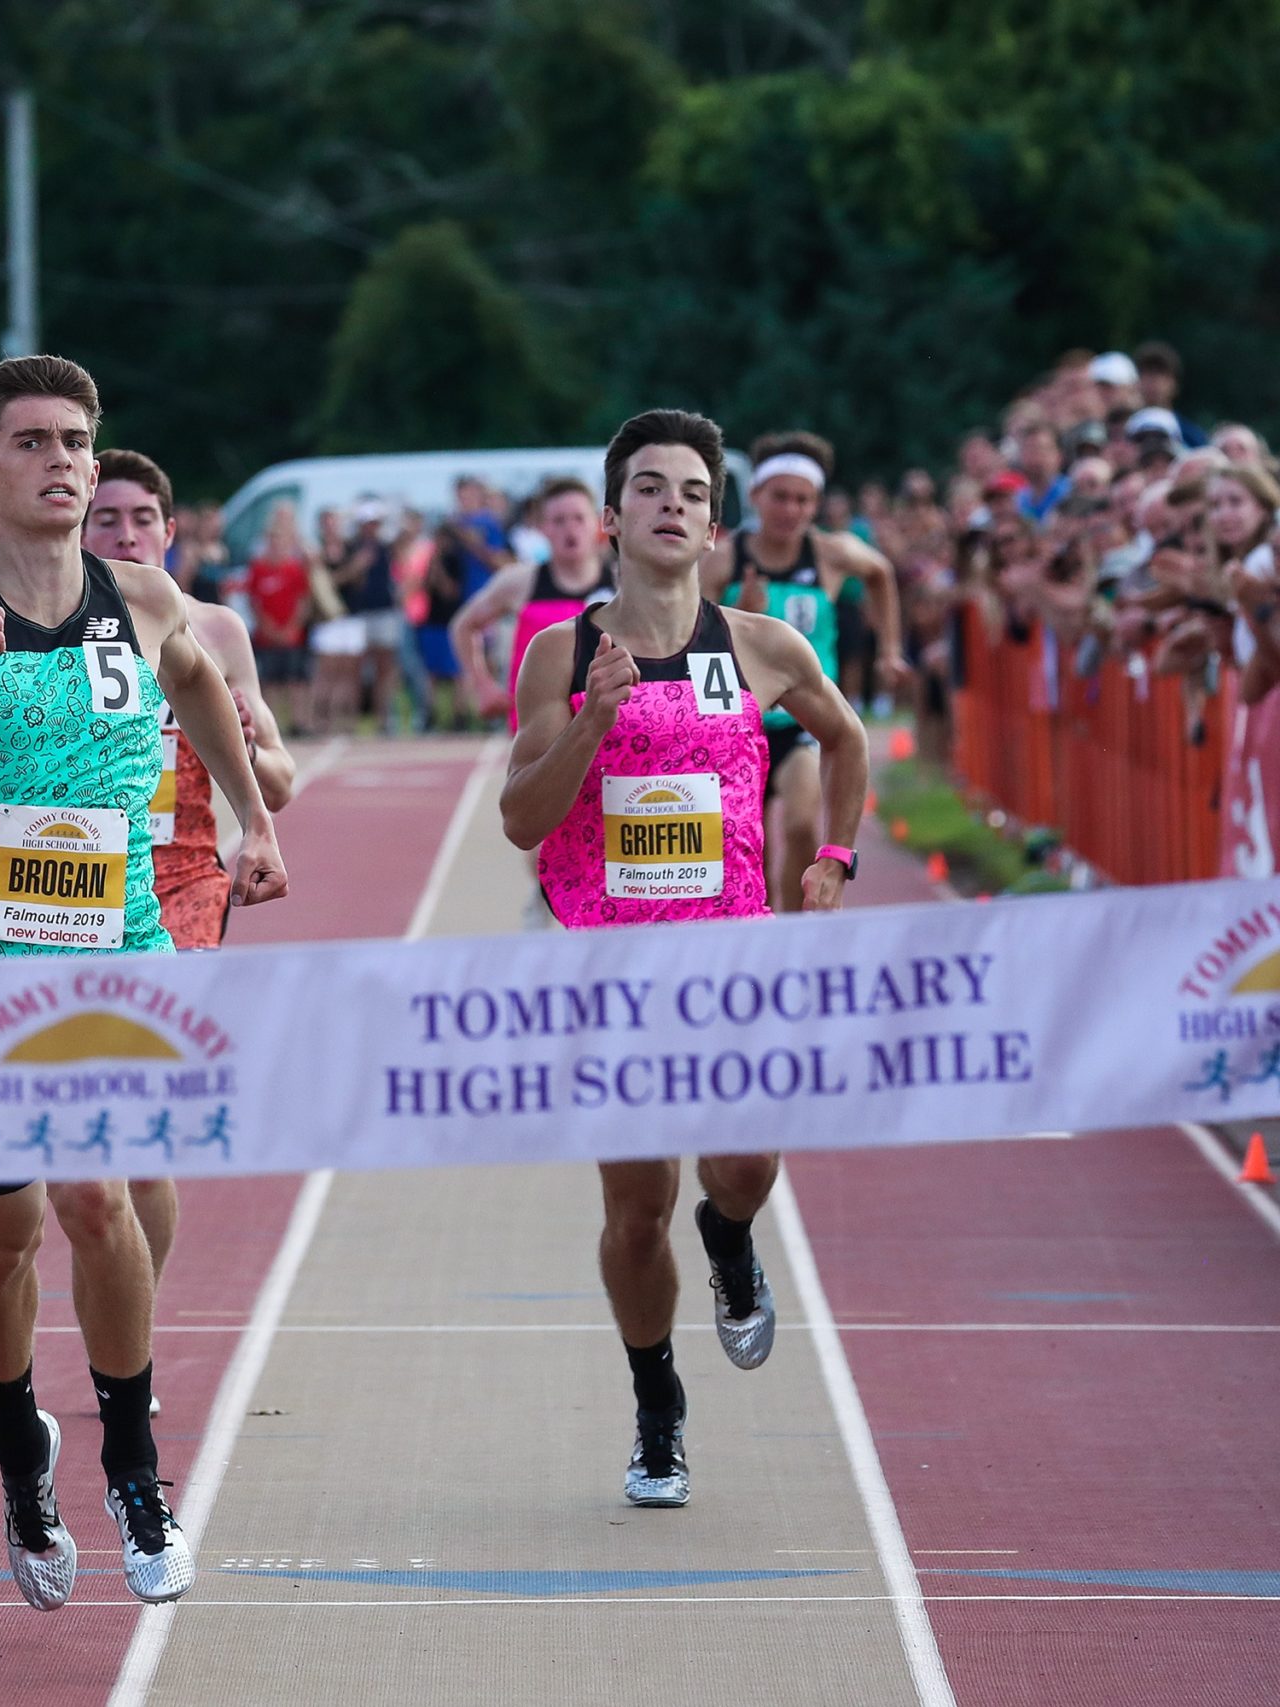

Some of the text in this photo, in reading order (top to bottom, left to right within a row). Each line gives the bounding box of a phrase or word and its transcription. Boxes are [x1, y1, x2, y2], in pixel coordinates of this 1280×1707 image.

[96, 647, 129, 710] 5
[704, 657, 734, 710] 4
[625, 779, 695, 804] TOMMY COCHARY
[24, 811, 102, 840] TOMMY COCHARY
[624, 804, 696, 814] HIGH SCHOOL MILE
[22, 839, 101, 852] HIGH SCHOOL MILE
[620, 822, 702, 856] GRIFFIN
[8, 857, 108, 898] BROGAN
[618, 867, 707, 880] Falmouth 2019
[623, 884, 703, 895] new balance
[3, 907, 105, 927] Falmouth 2019
[6, 927, 99, 943] new balance
[73, 970, 232, 1061] COCHARY
[411, 953, 994, 1045] TOMMY COCHARY
[1179, 1007, 1256, 1041] HIGH
[32, 1072, 153, 1104] SCHOOL
[164, 1066, 237, 1100] MILE
[385, 1029, 1032, 1118] HIGH SCHOOL MILE
